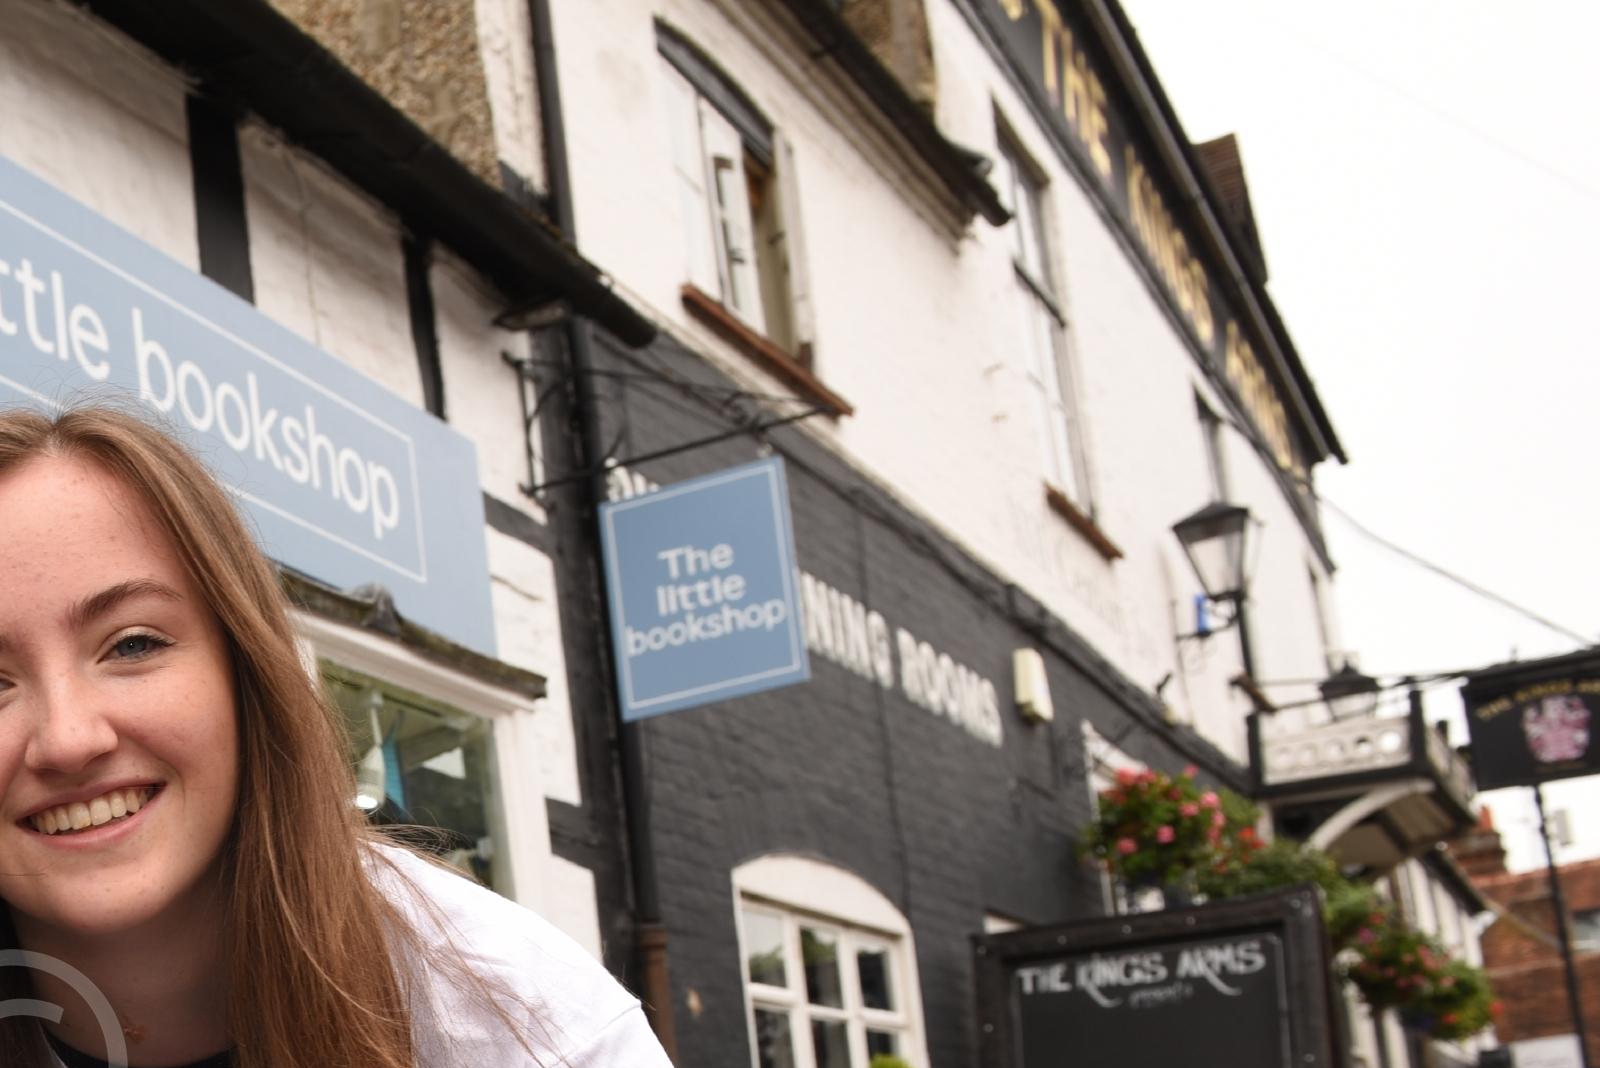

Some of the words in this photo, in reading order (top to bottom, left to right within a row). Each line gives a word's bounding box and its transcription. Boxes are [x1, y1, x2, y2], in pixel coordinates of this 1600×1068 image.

[132, 307, 399, 540] bookshop
[656, 543, 734, 579] The
[656, 574, 746, 617] little
[626, 598, 786, 656] bookshop
[1016, 963, 1072, 995] THE
[1177, 940, 1267, 996] ARMS
